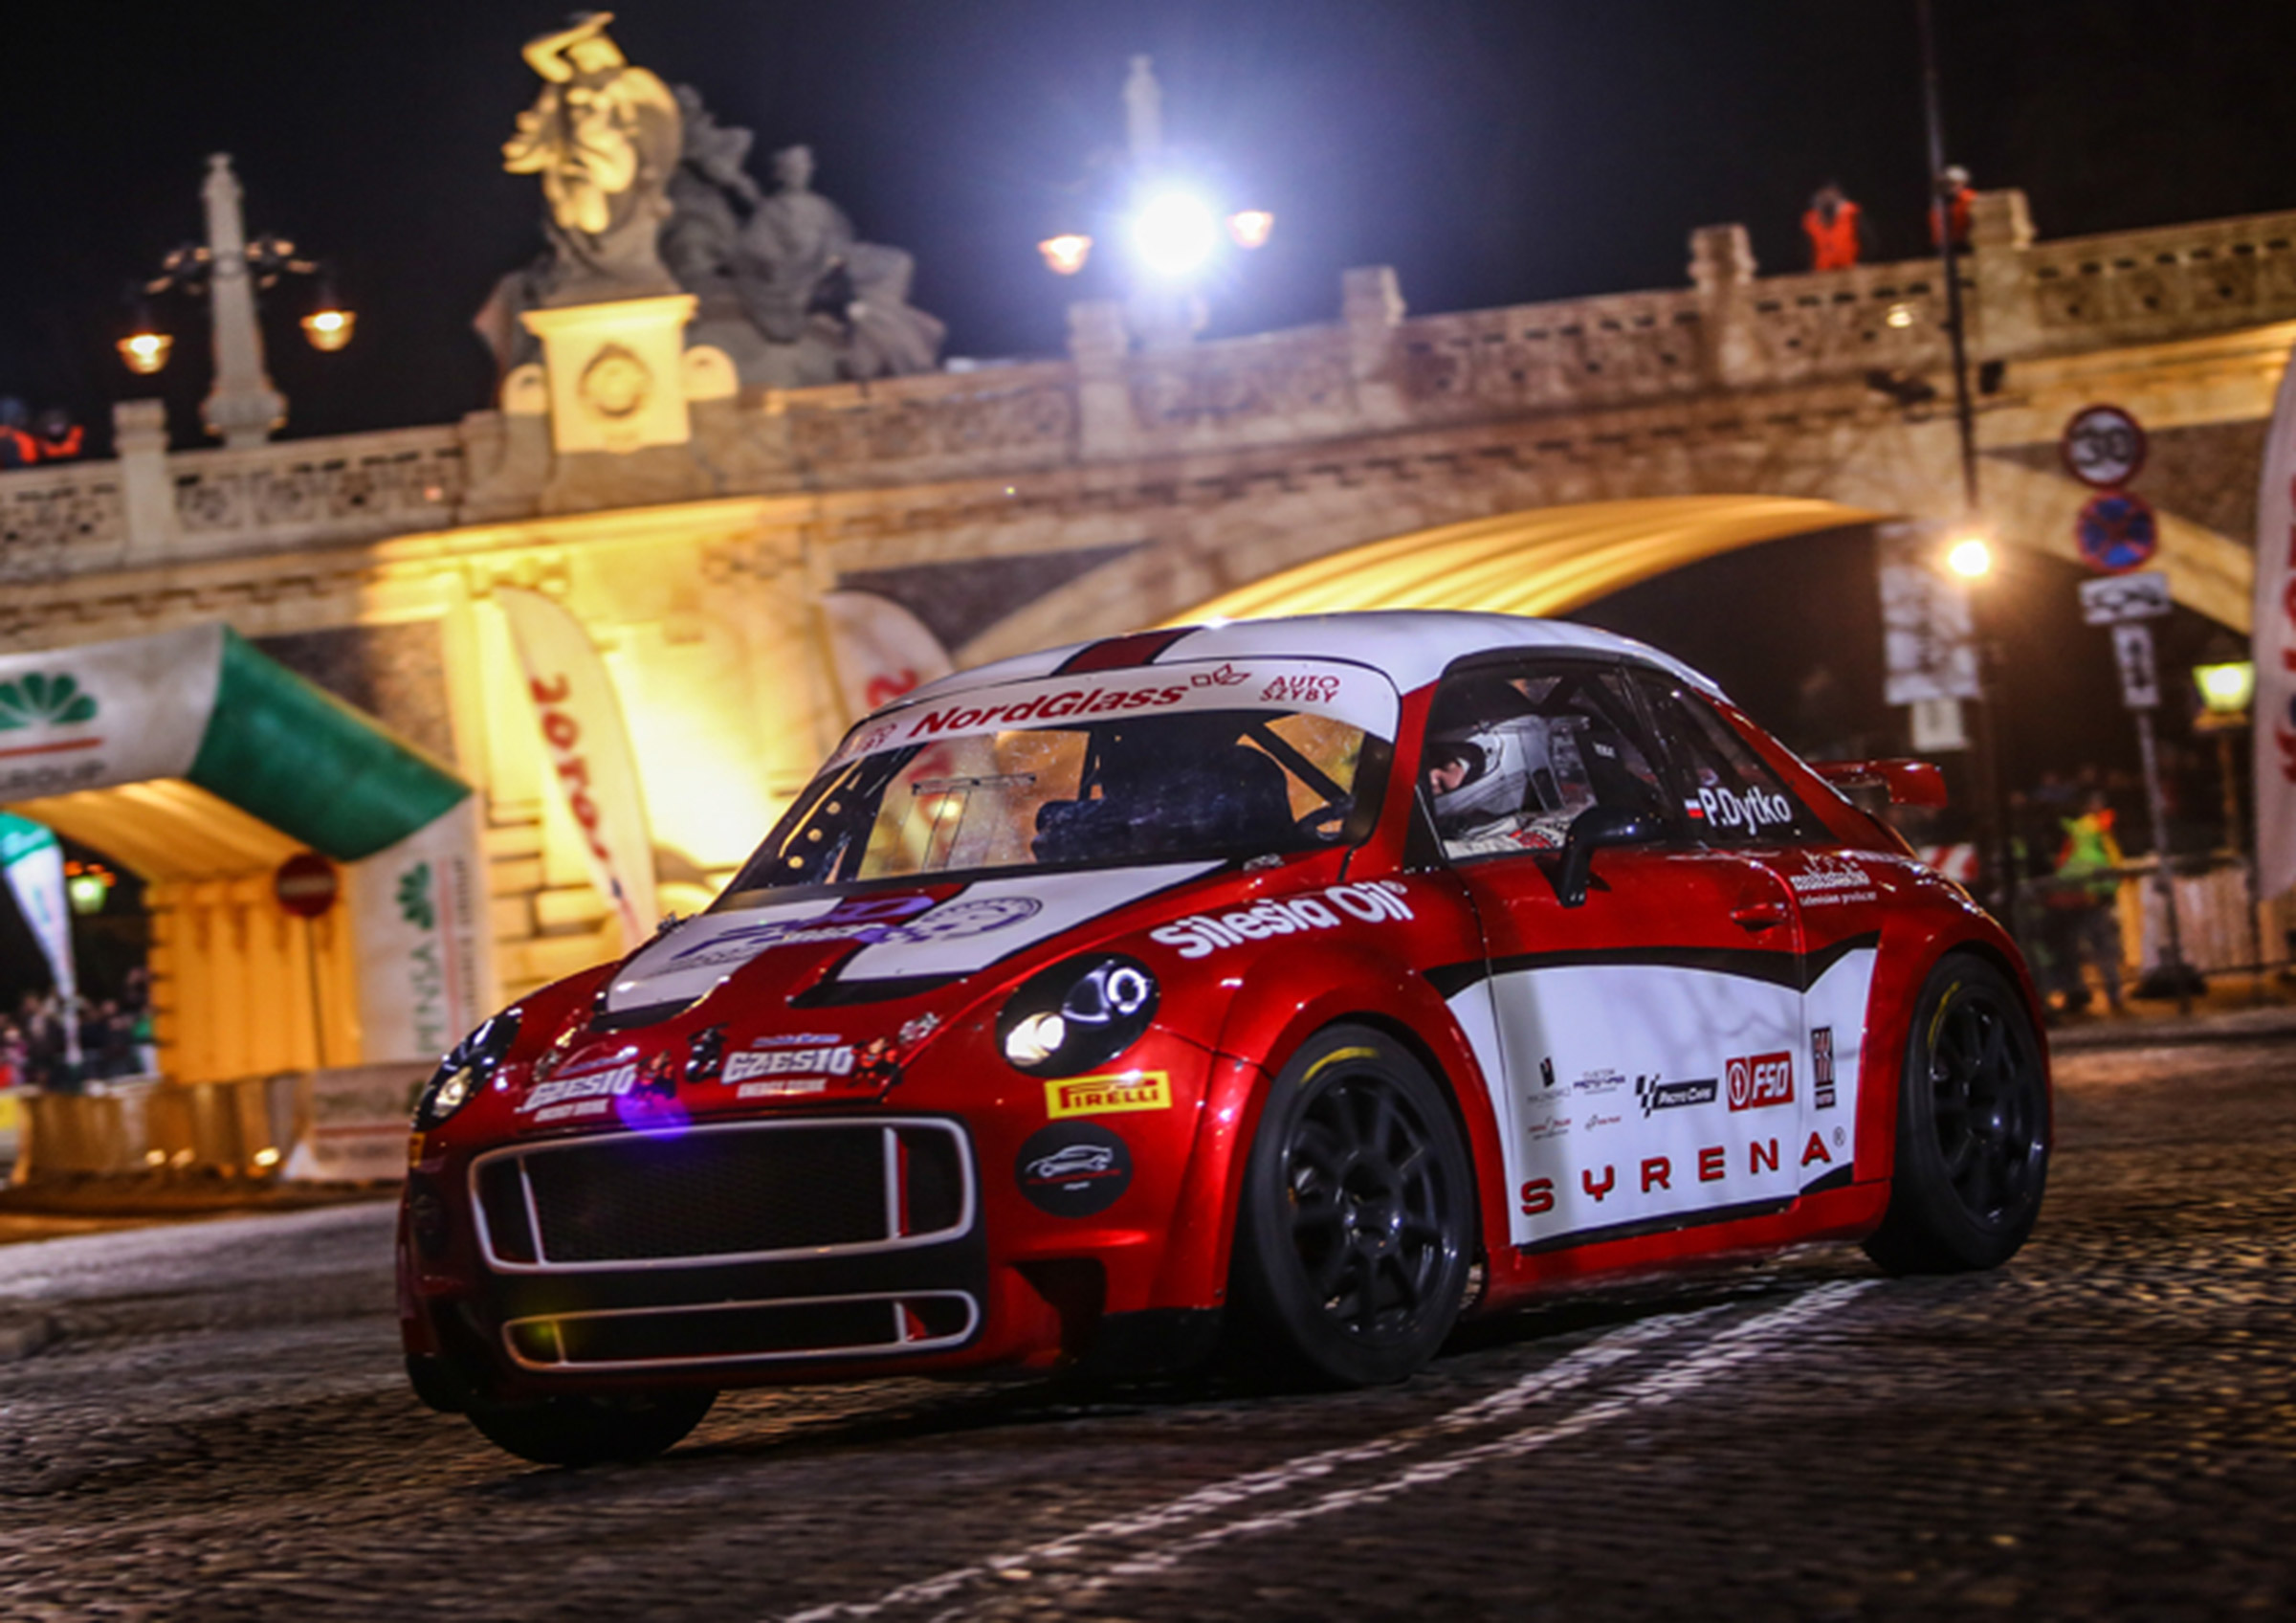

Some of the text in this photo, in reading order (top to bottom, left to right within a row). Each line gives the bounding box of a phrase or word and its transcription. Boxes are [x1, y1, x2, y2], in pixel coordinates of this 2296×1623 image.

[1259, 687, 1338, 703] SZYBY
[1265, 676, 1340, 689] AUTO
[907, 684, 1189, 739] NordGlass
[1697, 786, 1793, 835] P.Dytko
[1149, 898, 1341, 959] Silesia
[1058, 1078, 1159, 1110] PIRELLI
